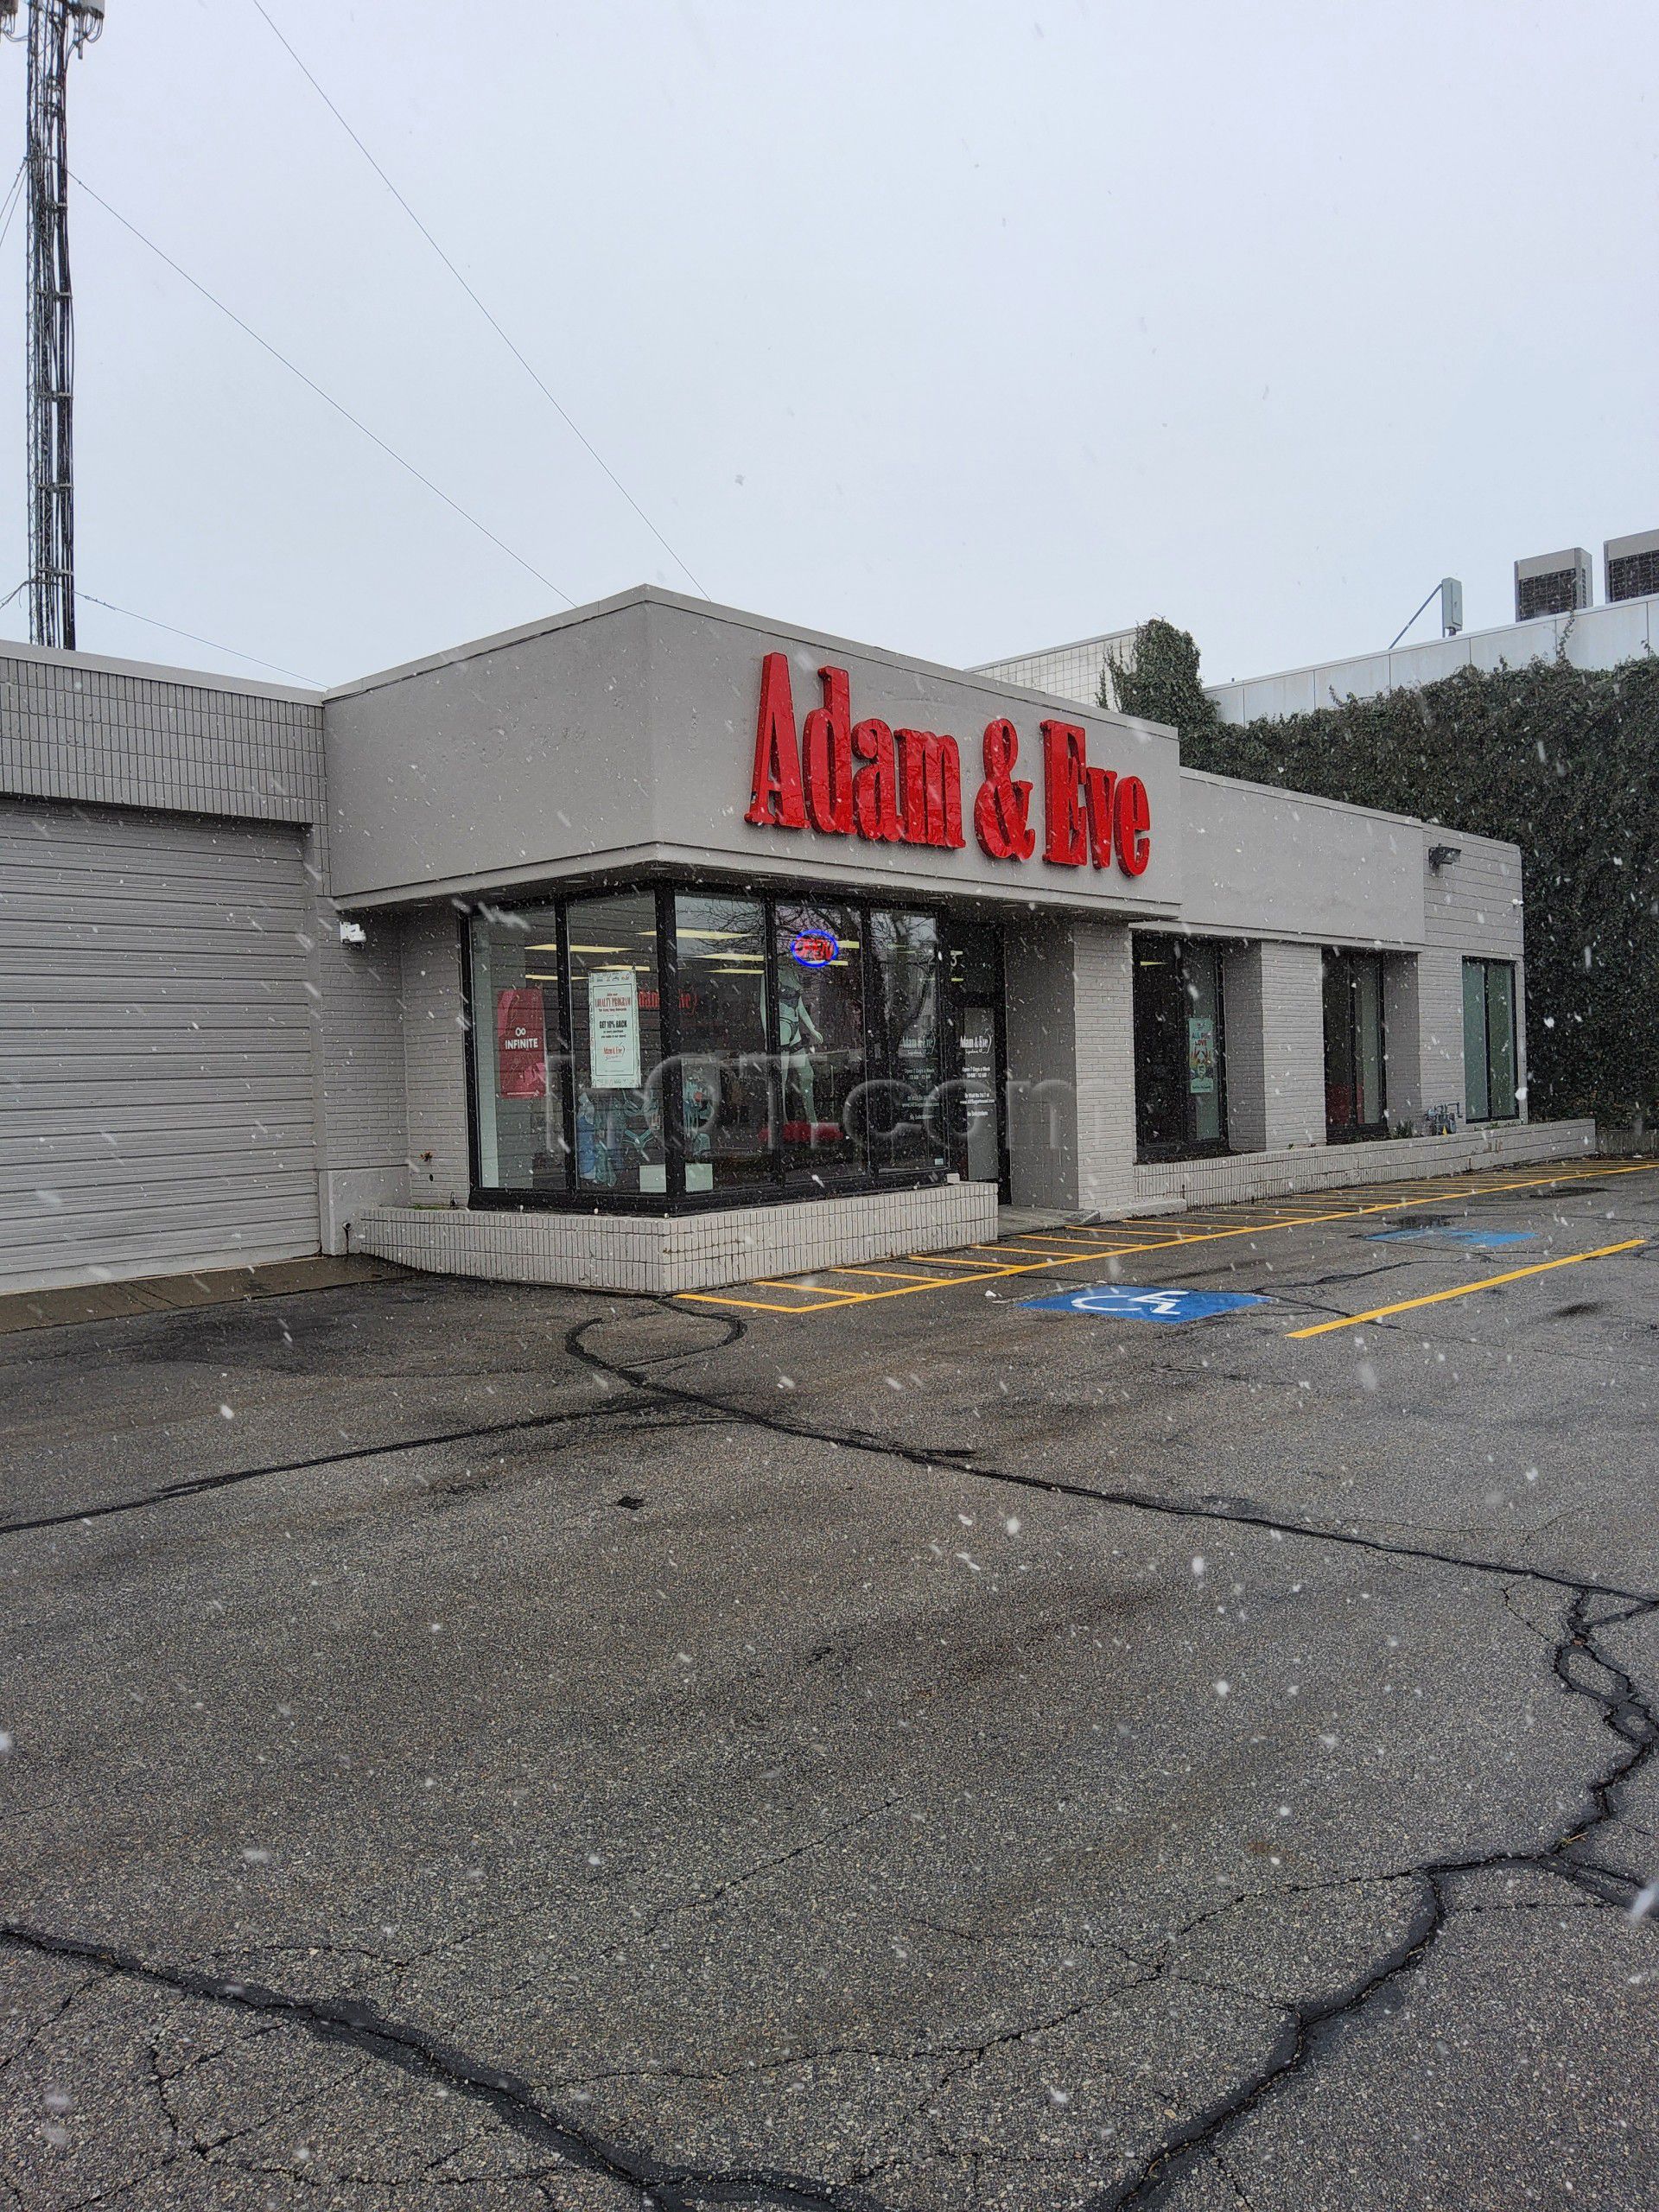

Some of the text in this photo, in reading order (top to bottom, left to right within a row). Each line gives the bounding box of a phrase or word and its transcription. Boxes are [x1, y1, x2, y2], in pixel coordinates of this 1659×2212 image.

[744, 652, 1151, 877] Adam & Eve
[794, 936, 835, 961] OPEN
[616, 1020, 627, 1028] BACK
[505, 1038, 539, 1050] INFINITE
[959, 1035, 974, 1048] Adam
[979, 1036, 988, 1048] Eve
